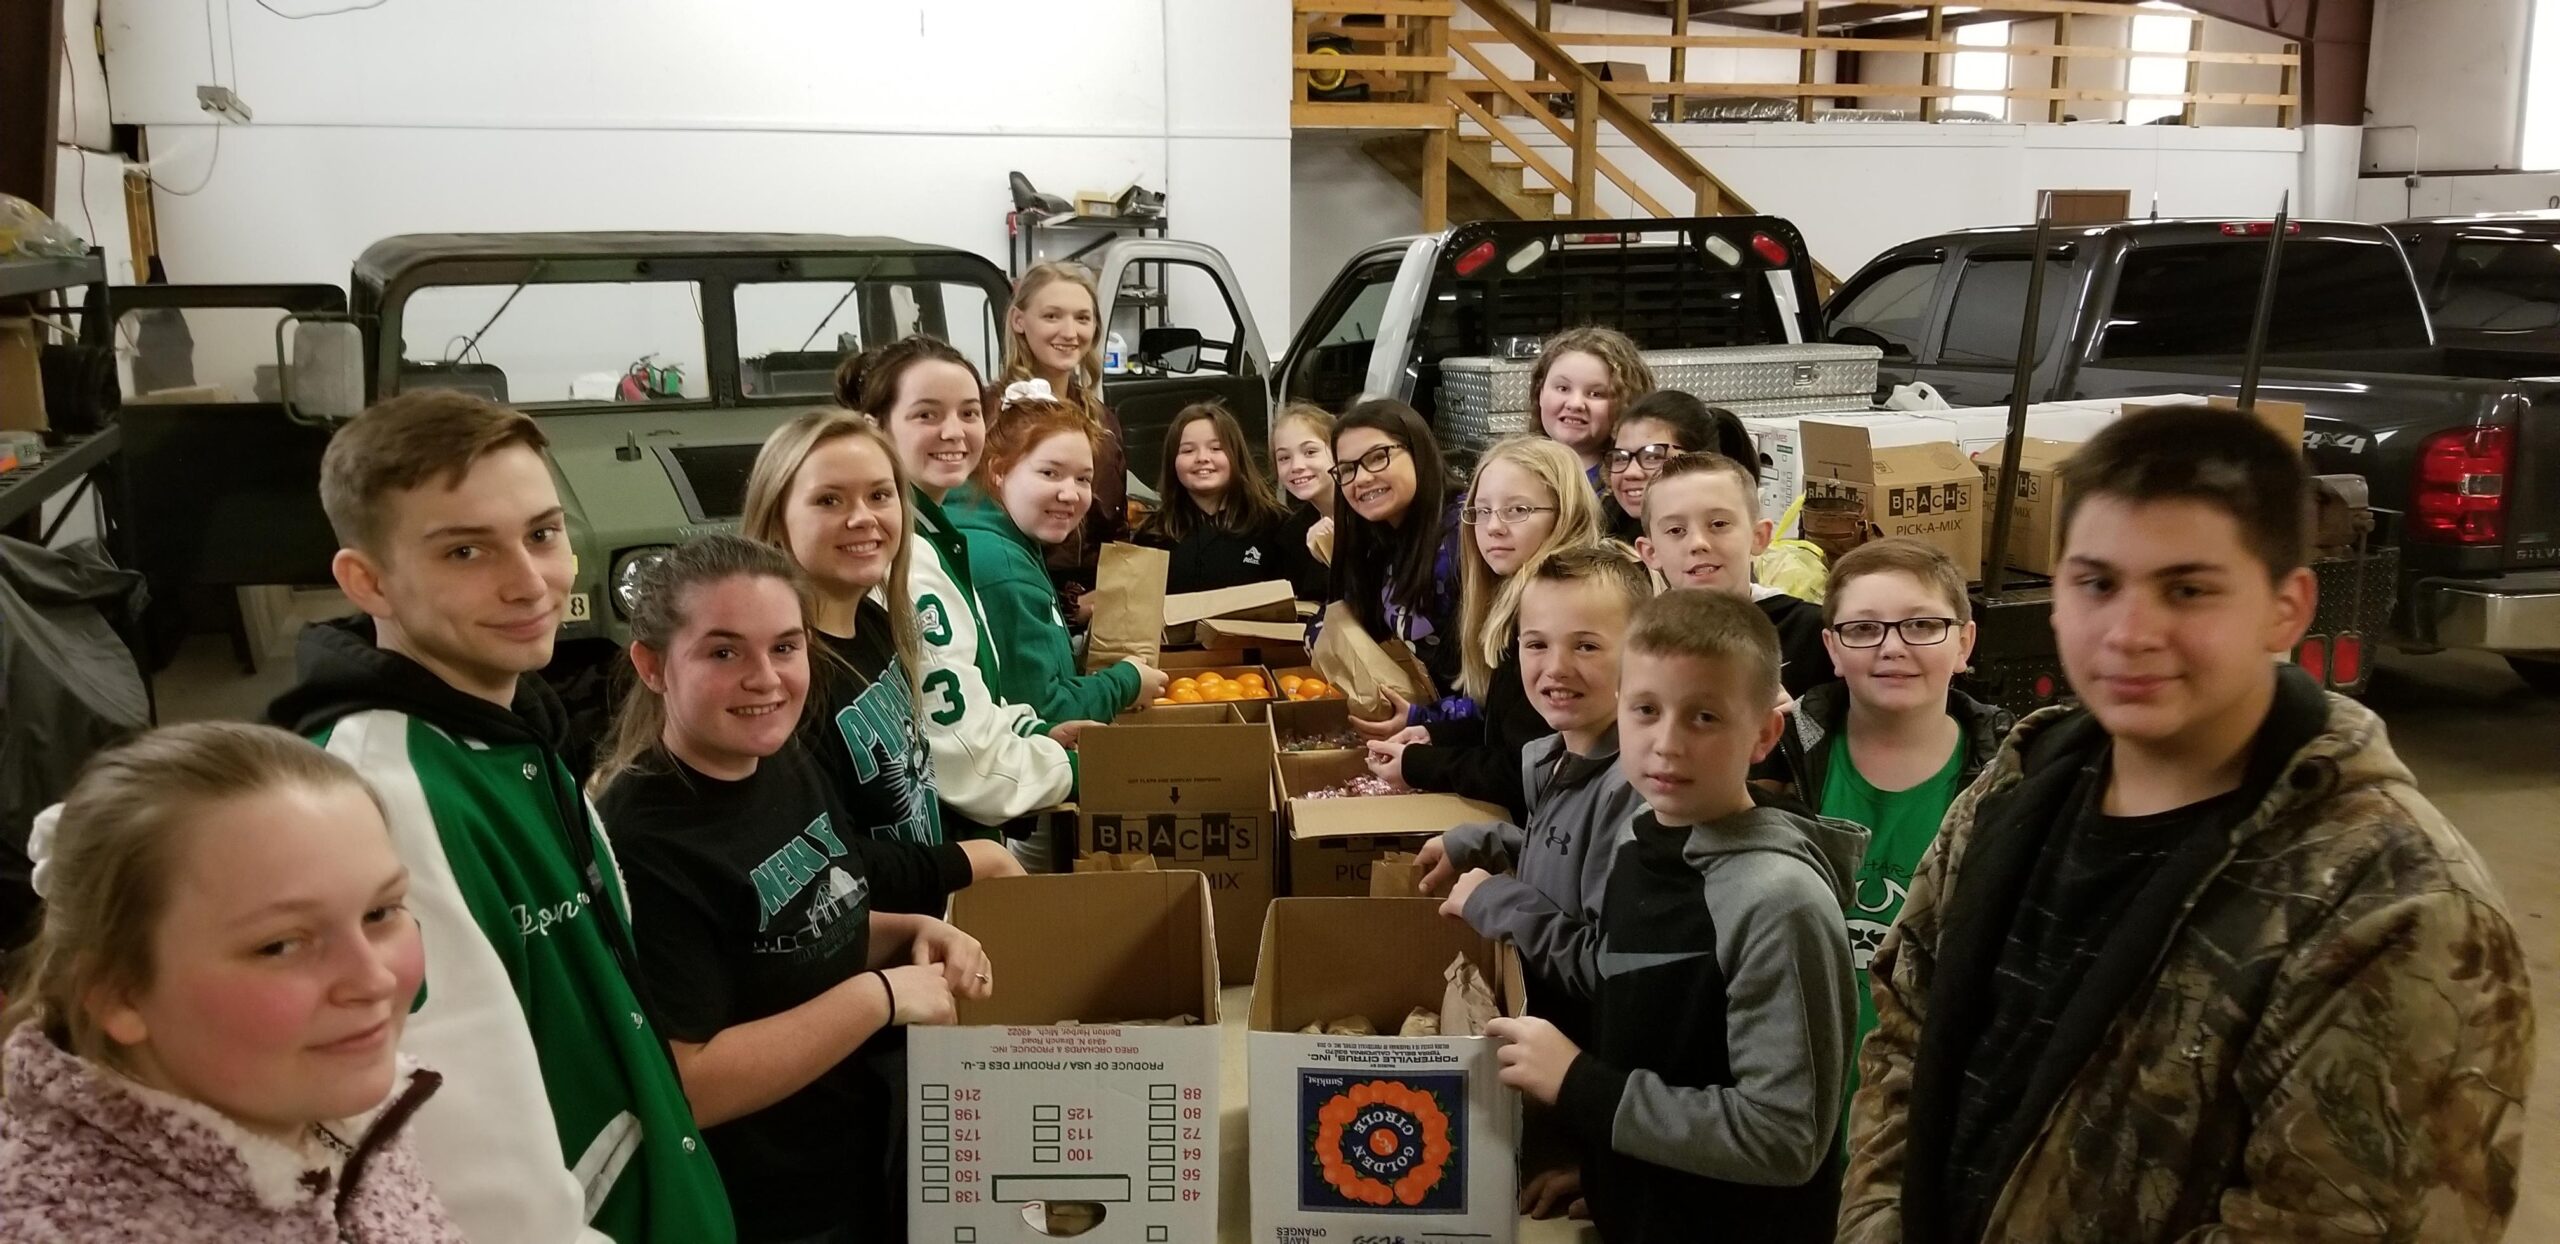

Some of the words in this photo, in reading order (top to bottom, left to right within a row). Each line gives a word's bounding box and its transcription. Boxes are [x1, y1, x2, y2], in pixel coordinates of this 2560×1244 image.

[1891, 488, 1968, 512] BRACH'S
[1896, 519, 1962, 536] PICK-A-MIX
[2517, 548, 2560, 559] SILV
[922, 668, 966, 726] 3
[1097, 821, 1252, 853] BRACH'S
[750, 835, 830, 916] NEW
[1064, 1046, 1113, 1054] ORCHARDS
[1114, 1046, 1139, 1054] GREG
[1383, 1055, 1459, 1063] PORTERVILLE
[988, 1061, 1010, 1070] DES
[1012, 1061, 1060, 1070] PRODUIT
[1070, 1061, 1092, 1070] USA
[1094, 1061, 1109, 1070] OF
[1111, 1061, 1164, 1070] PRODUCE
[954, 1088, 981, 1100] 216
[1183, 1088, 1202, 1100] 88
[955, 1109, 981, 1120] 198
[1067, 1108, 1093, 1120] 125
[1183, 1108, 1201, 1120] 80
[1353, 1110, 1414, 1137] CIRCLE
[955, 1129, 981, 1141] 175
[1067, 1128, 1093, 1140] 113
[1183, 1128, 1201, 1140] 72
[955, 1149, 981, 1161] 163
[1067, 1149, 1093, 1161] 100
[1183, 1148, 1201, 1160] 64
[1353, 1144, 1415, 1174] GOLDEN
[955, 1170, 981, 1182] 150
[1182, 1168, 1201, 1180] 56
[955, 1190, 981, 1202] 138
[1182, 1189, 1201, 1201] 48
[1276, 1227, 1327, 1237] ORANGES
